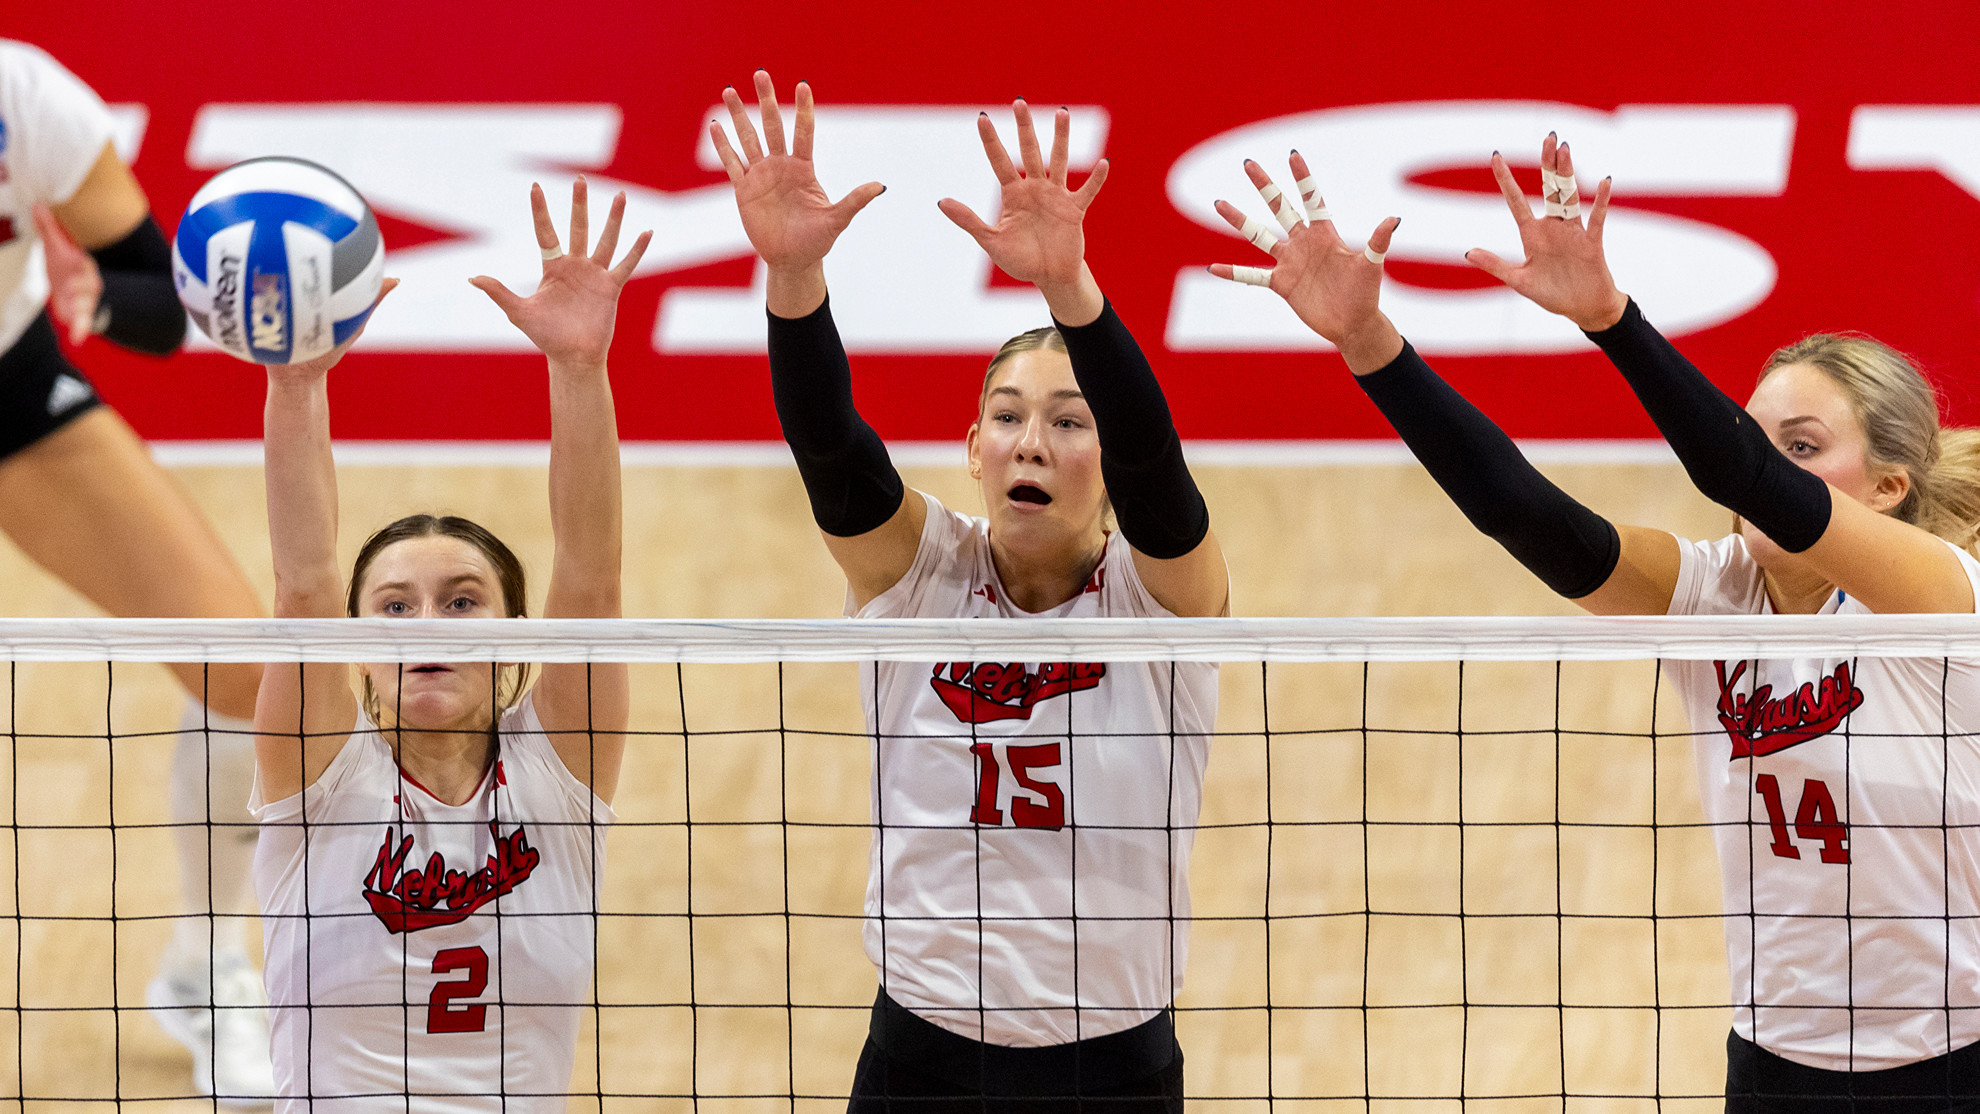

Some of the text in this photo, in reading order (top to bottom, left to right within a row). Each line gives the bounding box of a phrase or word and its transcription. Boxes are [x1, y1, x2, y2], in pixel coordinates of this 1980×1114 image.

[968, 742, 1066, 832] 15
[1755, 773, 1852, 864] 14
[426, 945, 489, 1034] 2
